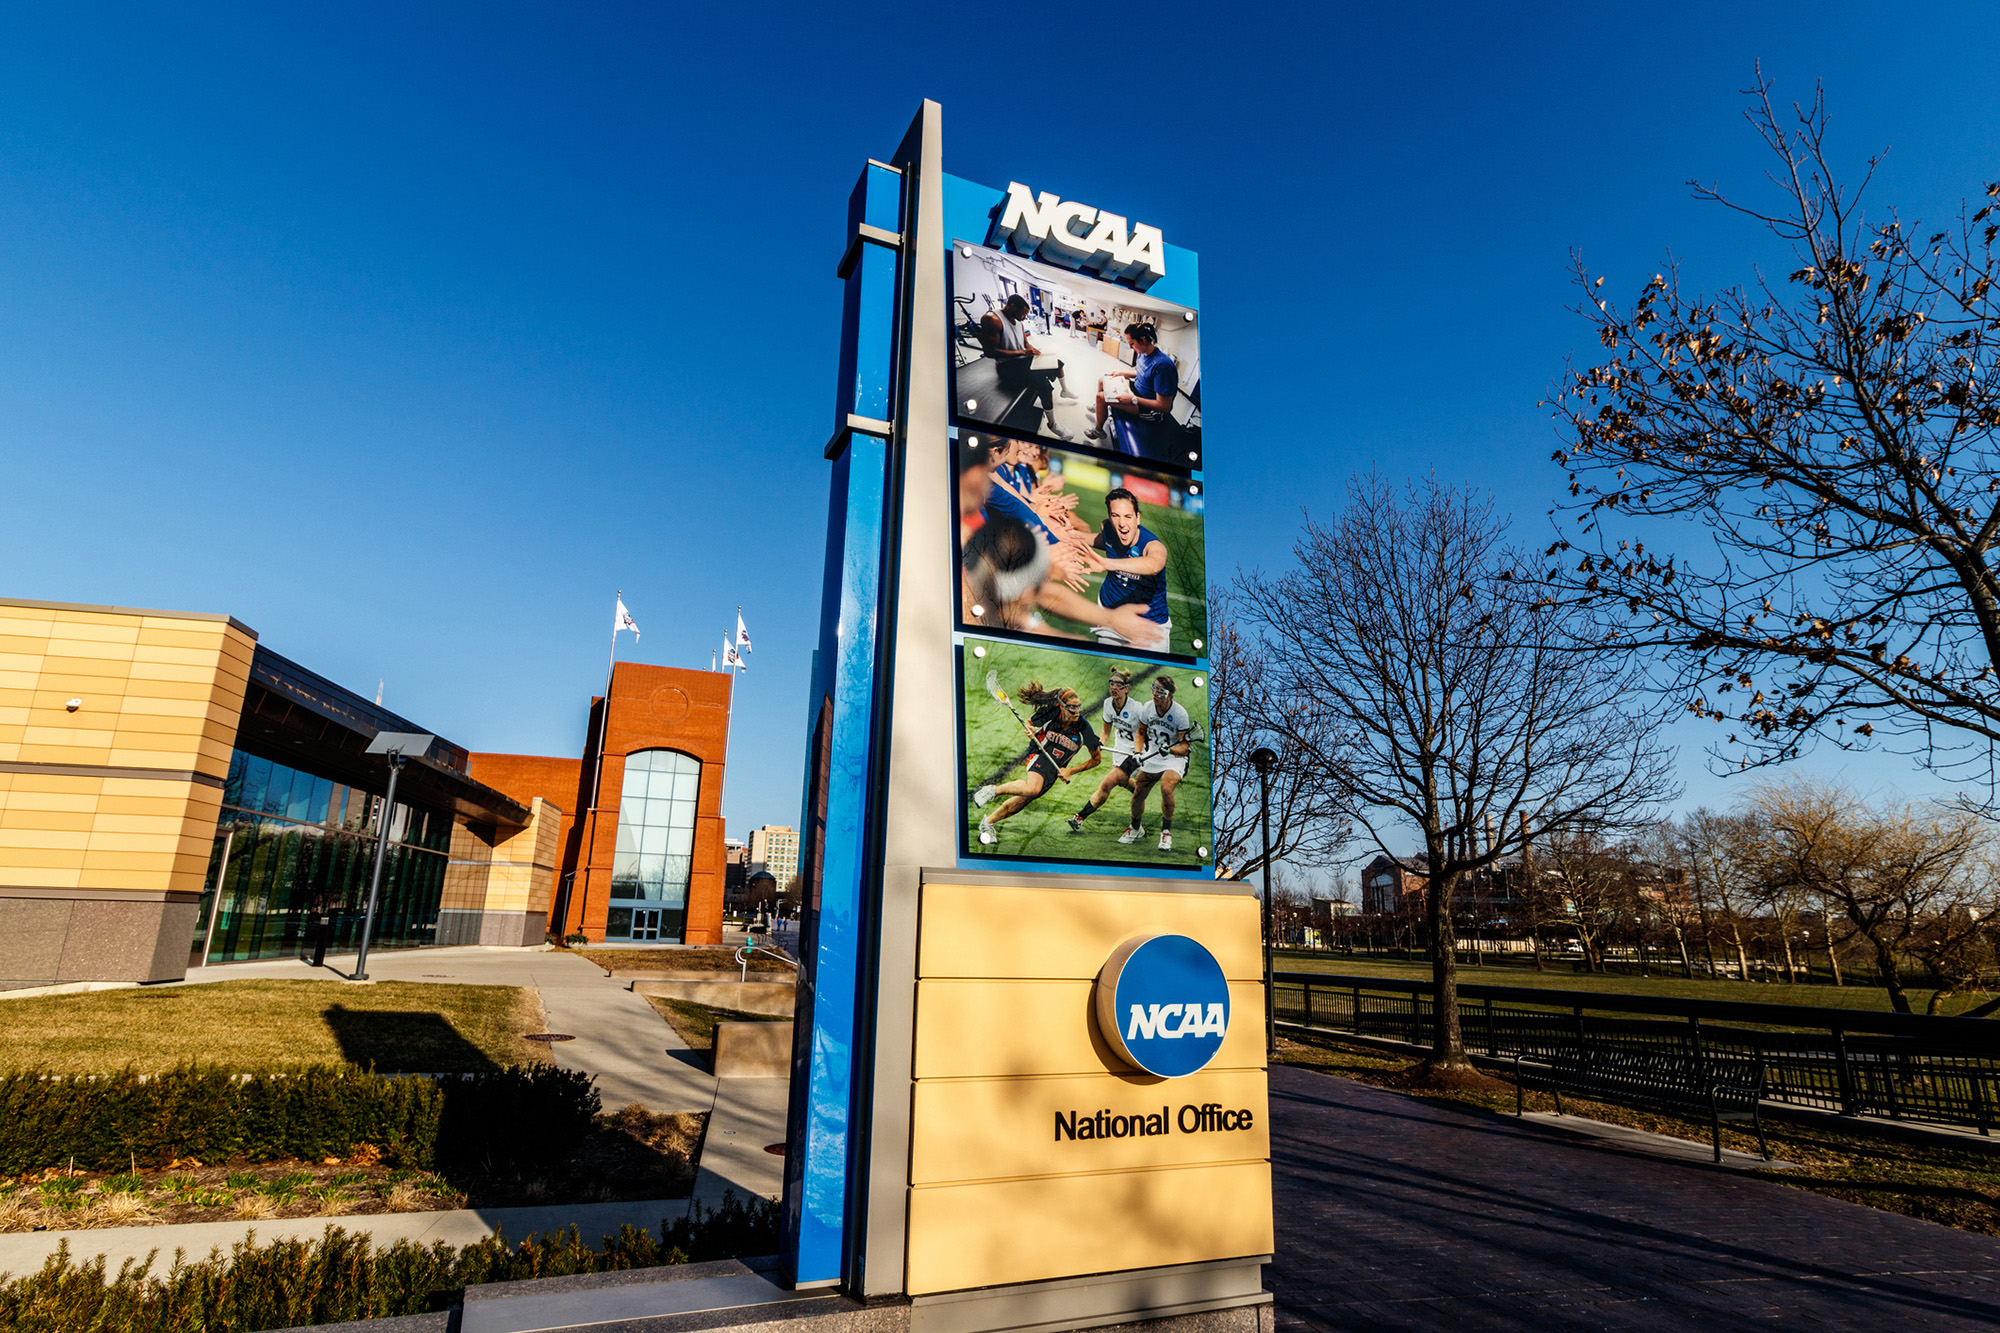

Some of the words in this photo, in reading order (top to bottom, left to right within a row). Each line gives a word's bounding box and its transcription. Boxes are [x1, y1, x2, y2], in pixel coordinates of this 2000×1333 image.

[1000, 181, 1166, 277] NCAA
[1052, 747, 1065, 760] 7
[1126, 1003, 1226, 1041] NCAA
[1054, 1106, 1170, 1142] National
[1177, 1102, 1254, 1134] Office
